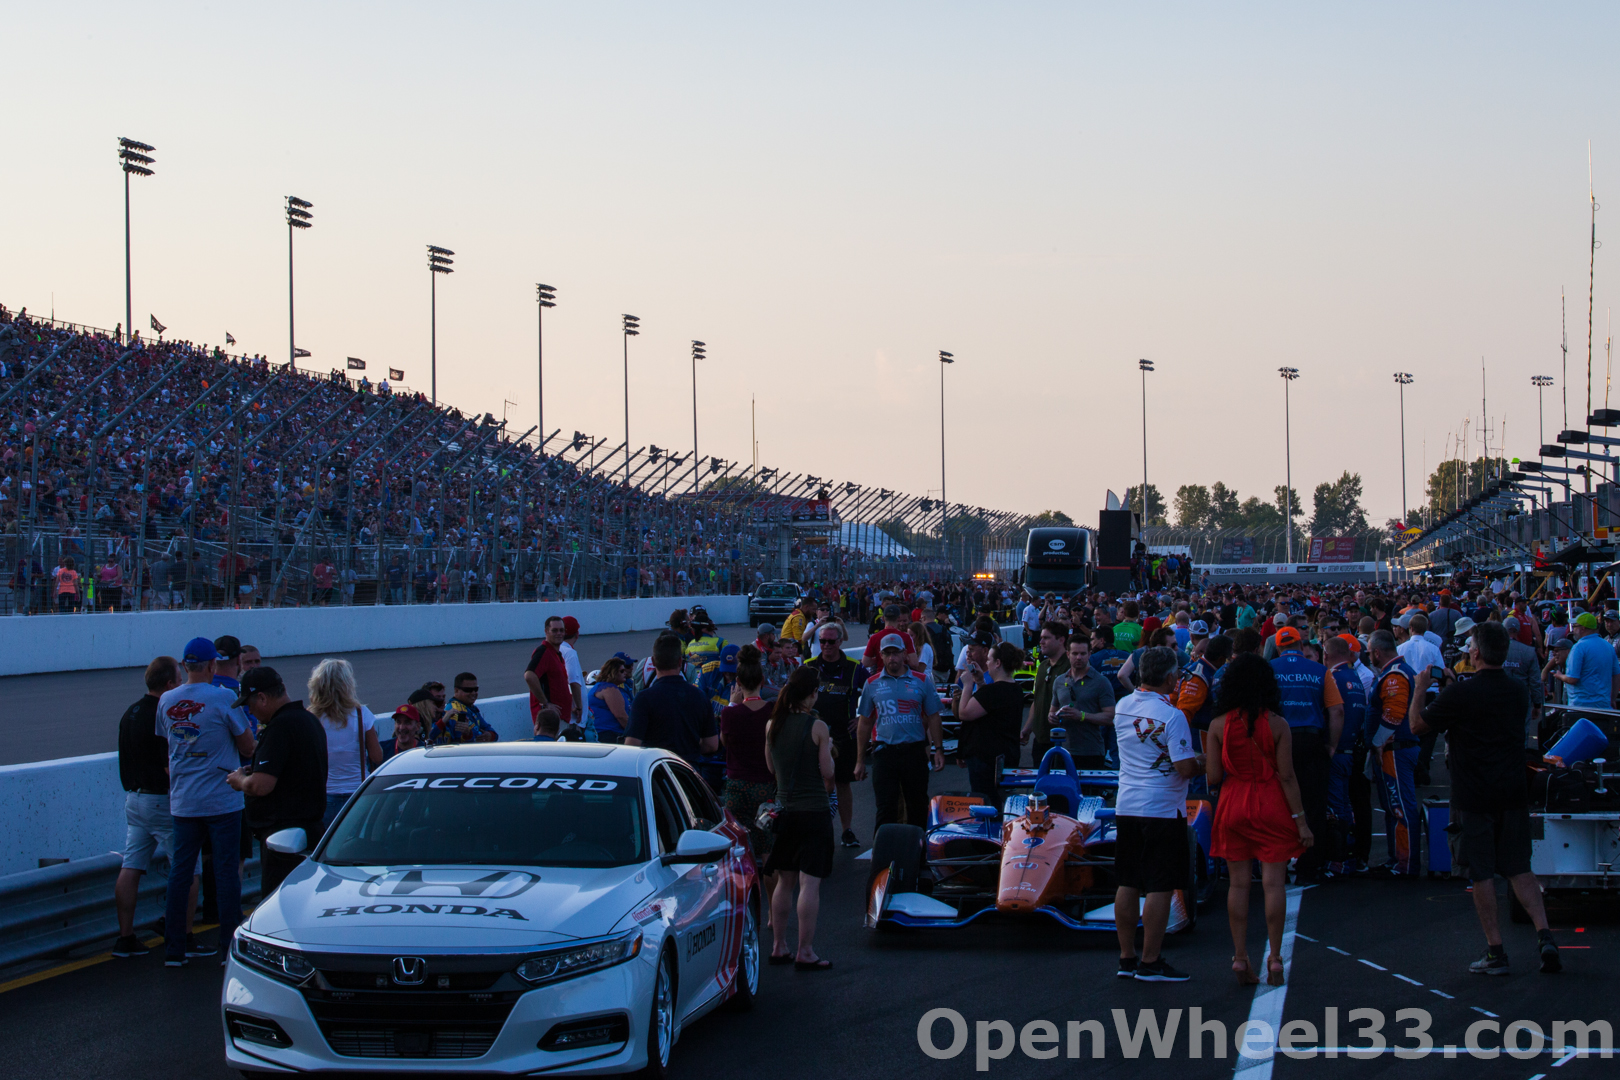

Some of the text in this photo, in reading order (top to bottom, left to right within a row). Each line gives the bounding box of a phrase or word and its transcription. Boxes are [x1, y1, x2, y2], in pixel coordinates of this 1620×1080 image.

[876, 699, 897, 716] US
[881, 714, 921, 726] CONCRETE
[384, 777, 618, 791] ACCORD
[1022, 837, 1045, 849] 9
[317, 904, 529, 921] HONDA
[692, 923, 716, 956] HONDA
